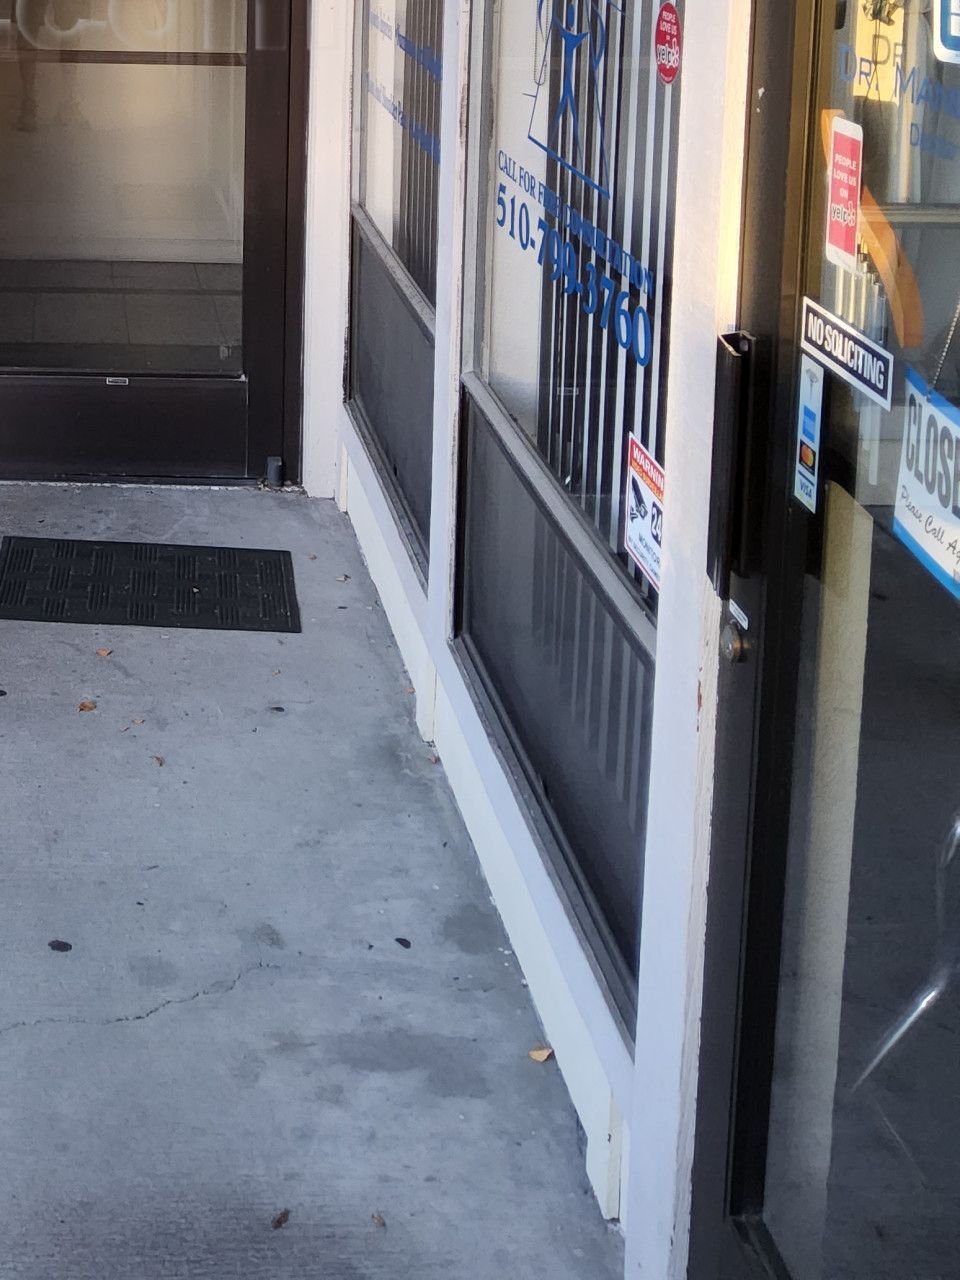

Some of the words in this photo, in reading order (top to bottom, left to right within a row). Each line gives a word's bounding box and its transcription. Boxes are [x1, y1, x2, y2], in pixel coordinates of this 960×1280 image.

[834, 153, 857, 171] PEOPLE
[498, 150, 516, 183] CALL
[519, 166, 536, 199] FOR
[833, 169, 848, 183] LOVE
[848, 175, 857, 187] US
[839, 187, 849, 200] ON
[831, 203, 850, 228] yelp
[807, 312, 823, 347] NO
[823, 325, 885, 391] SOLICITING
[799, 481, 812, 498] VISA
[901, 484, 923, 524] Please
[924, 515, 945, 545] Call
